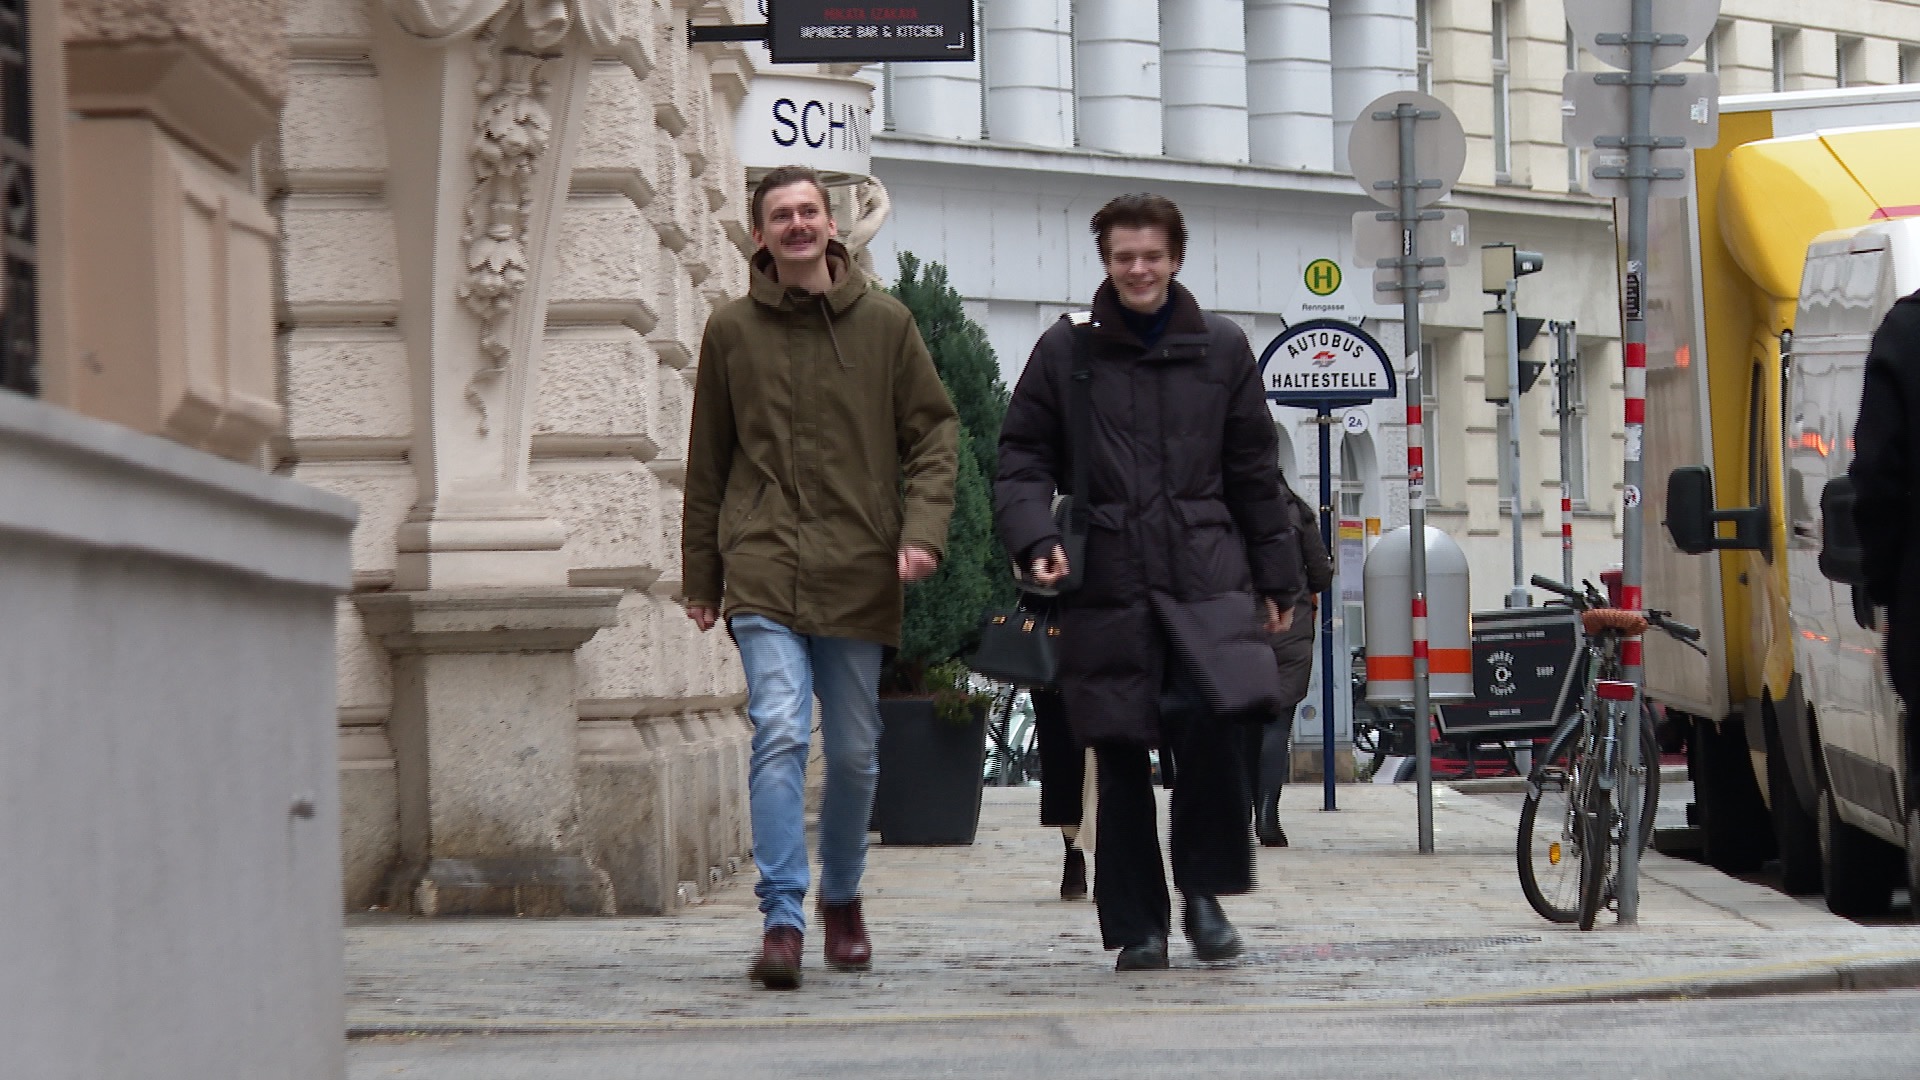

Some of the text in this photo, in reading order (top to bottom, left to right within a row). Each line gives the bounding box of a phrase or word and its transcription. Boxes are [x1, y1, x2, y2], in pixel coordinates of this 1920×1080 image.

[800, 25, 944, 38] JAPANESE BAR & KITCHEN
[1313, 266, 1332, 289] H
[1302, 303, 1345, 312] Renngasse
[1287, 332, 1364, 359] AUTOBUS
[1272, 372, 1377, 388] HALTESTELLE
[1348, 417, 1363, 428] 2A
[1487, 650, 1514, 665] WHEEL
